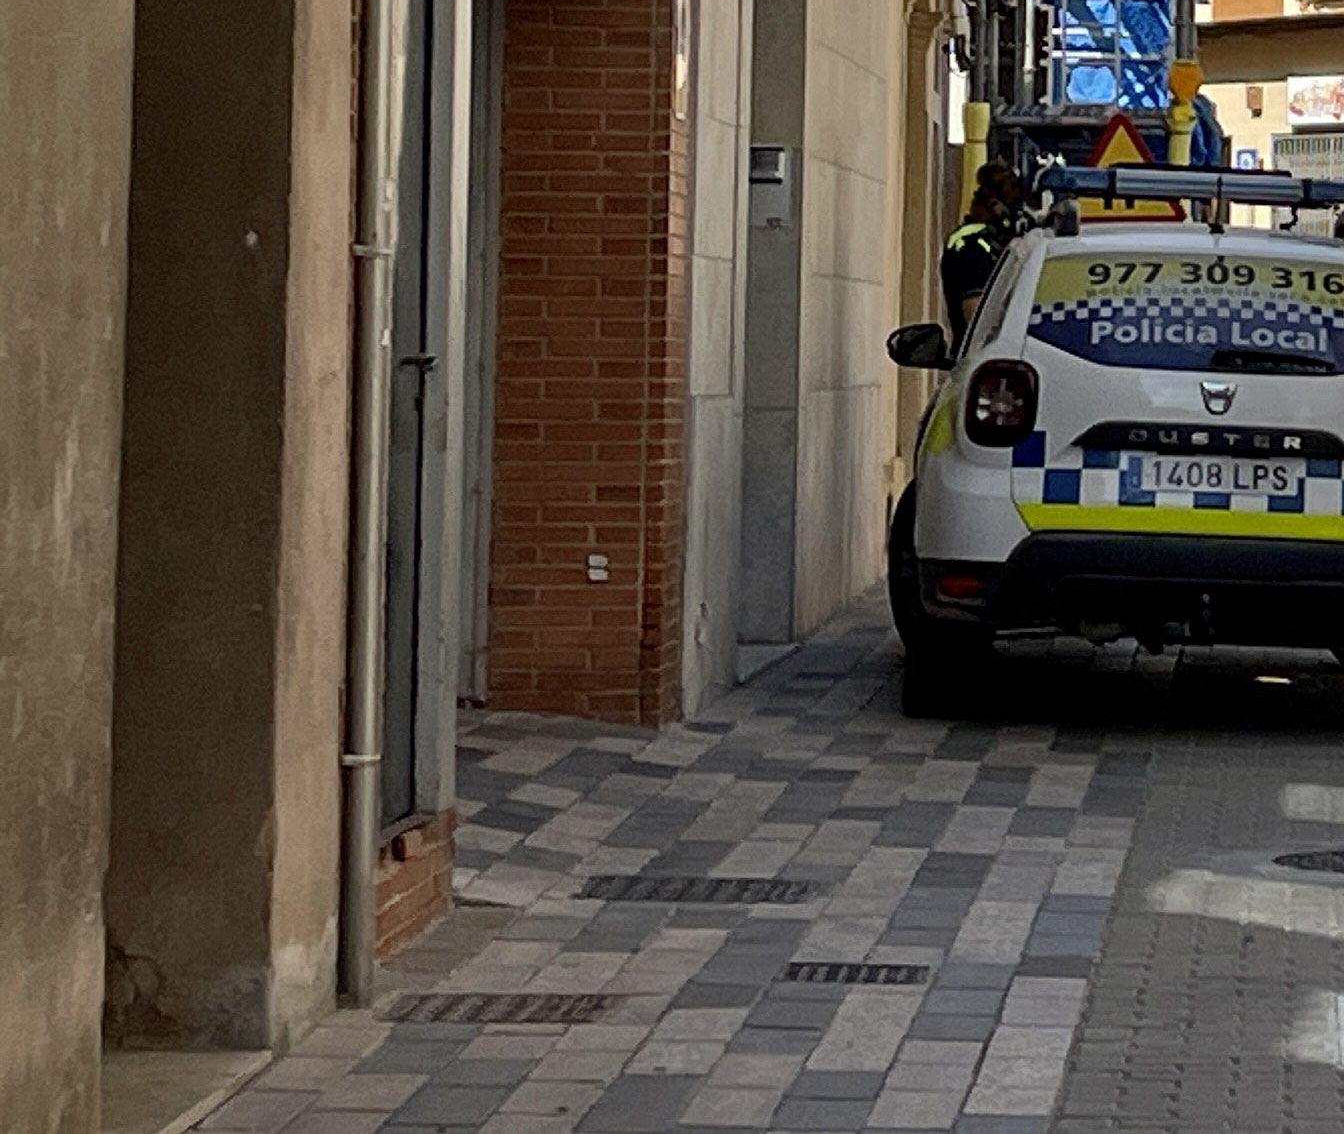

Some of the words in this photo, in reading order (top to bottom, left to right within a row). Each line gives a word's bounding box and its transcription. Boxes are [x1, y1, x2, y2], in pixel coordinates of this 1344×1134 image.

[1087, 262, 1164, 286] 977
[1180, 262, 1256, 286] 309
[1091, 318, 1218, 345] Policia
[1231, 321, 1329, 352] Local
[1128, 429, 1302, 450] DUSTER
[1152, 462, 1222, 487] 1408
[1233, 463, 1288, 491] LPS
